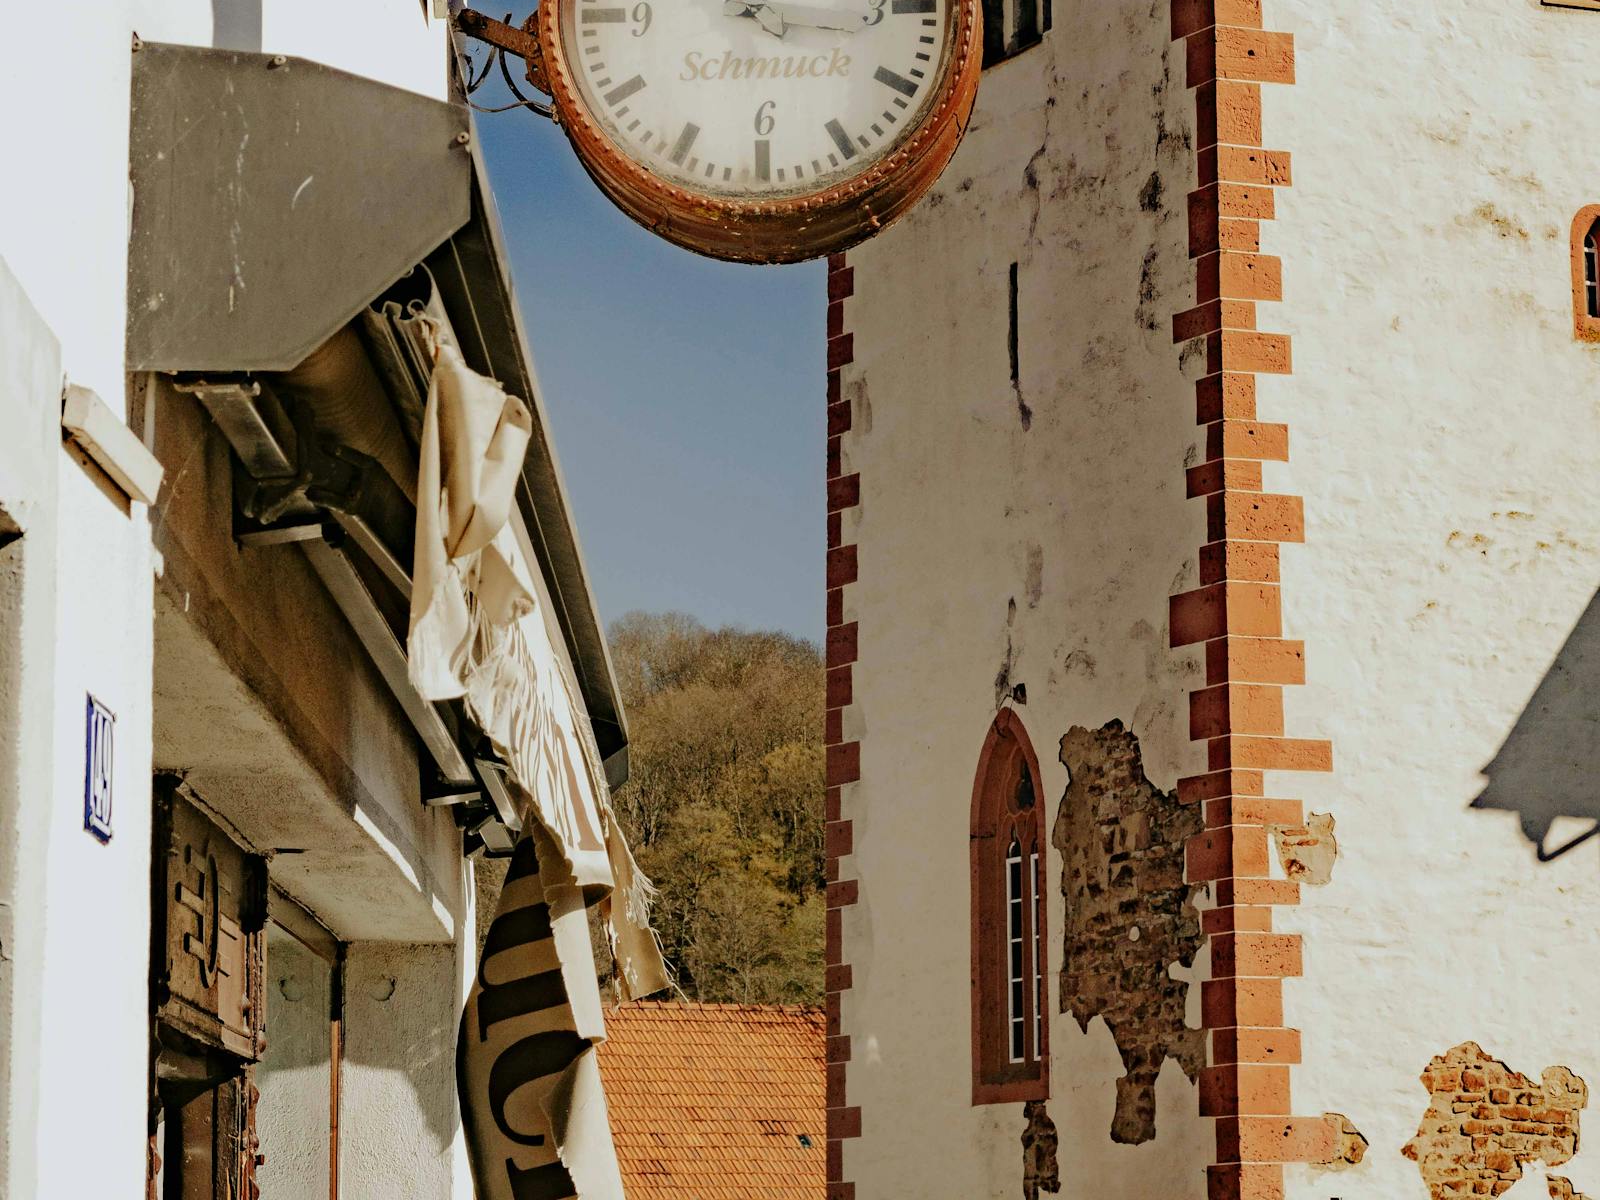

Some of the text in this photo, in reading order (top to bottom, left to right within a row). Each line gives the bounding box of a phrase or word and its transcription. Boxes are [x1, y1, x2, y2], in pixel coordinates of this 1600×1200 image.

[631, 1, 653, 38] 9
[679, 47, 852, 82] Schmuck
[754, 100, 776, 136] 6
